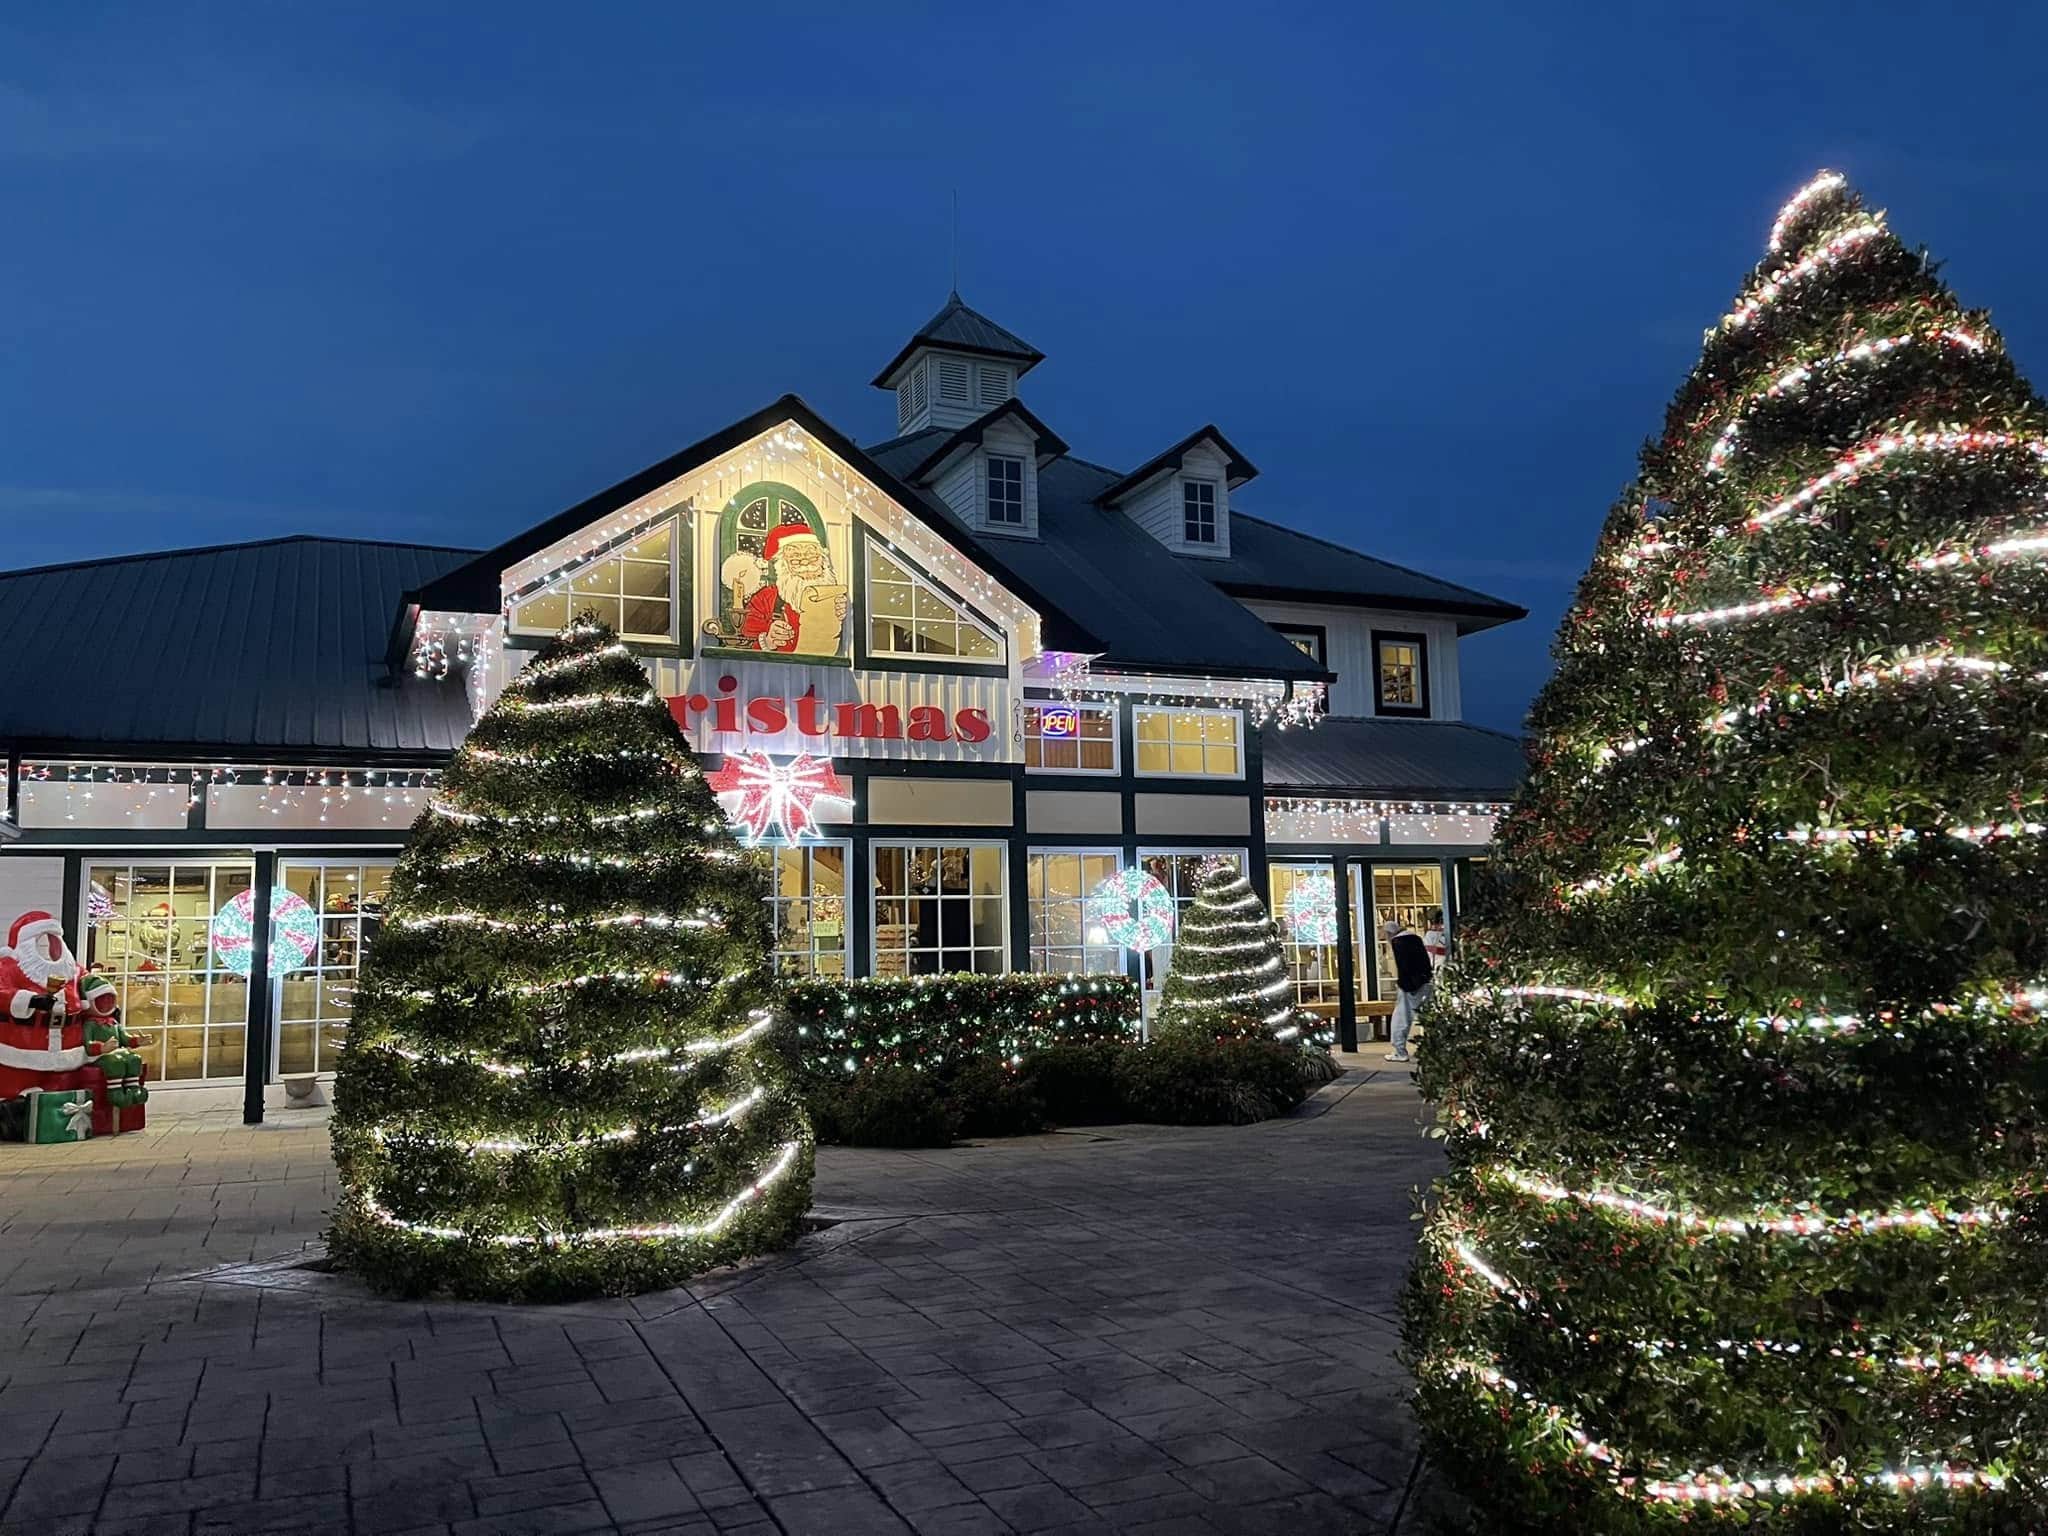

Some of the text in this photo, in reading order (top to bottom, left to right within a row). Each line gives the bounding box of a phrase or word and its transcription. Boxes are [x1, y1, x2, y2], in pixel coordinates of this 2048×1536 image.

[664, 675, 991, 743] ristmas
[1013, 698, 1022, 743] 216
[1041, 714, 1076, 732] OPEN
